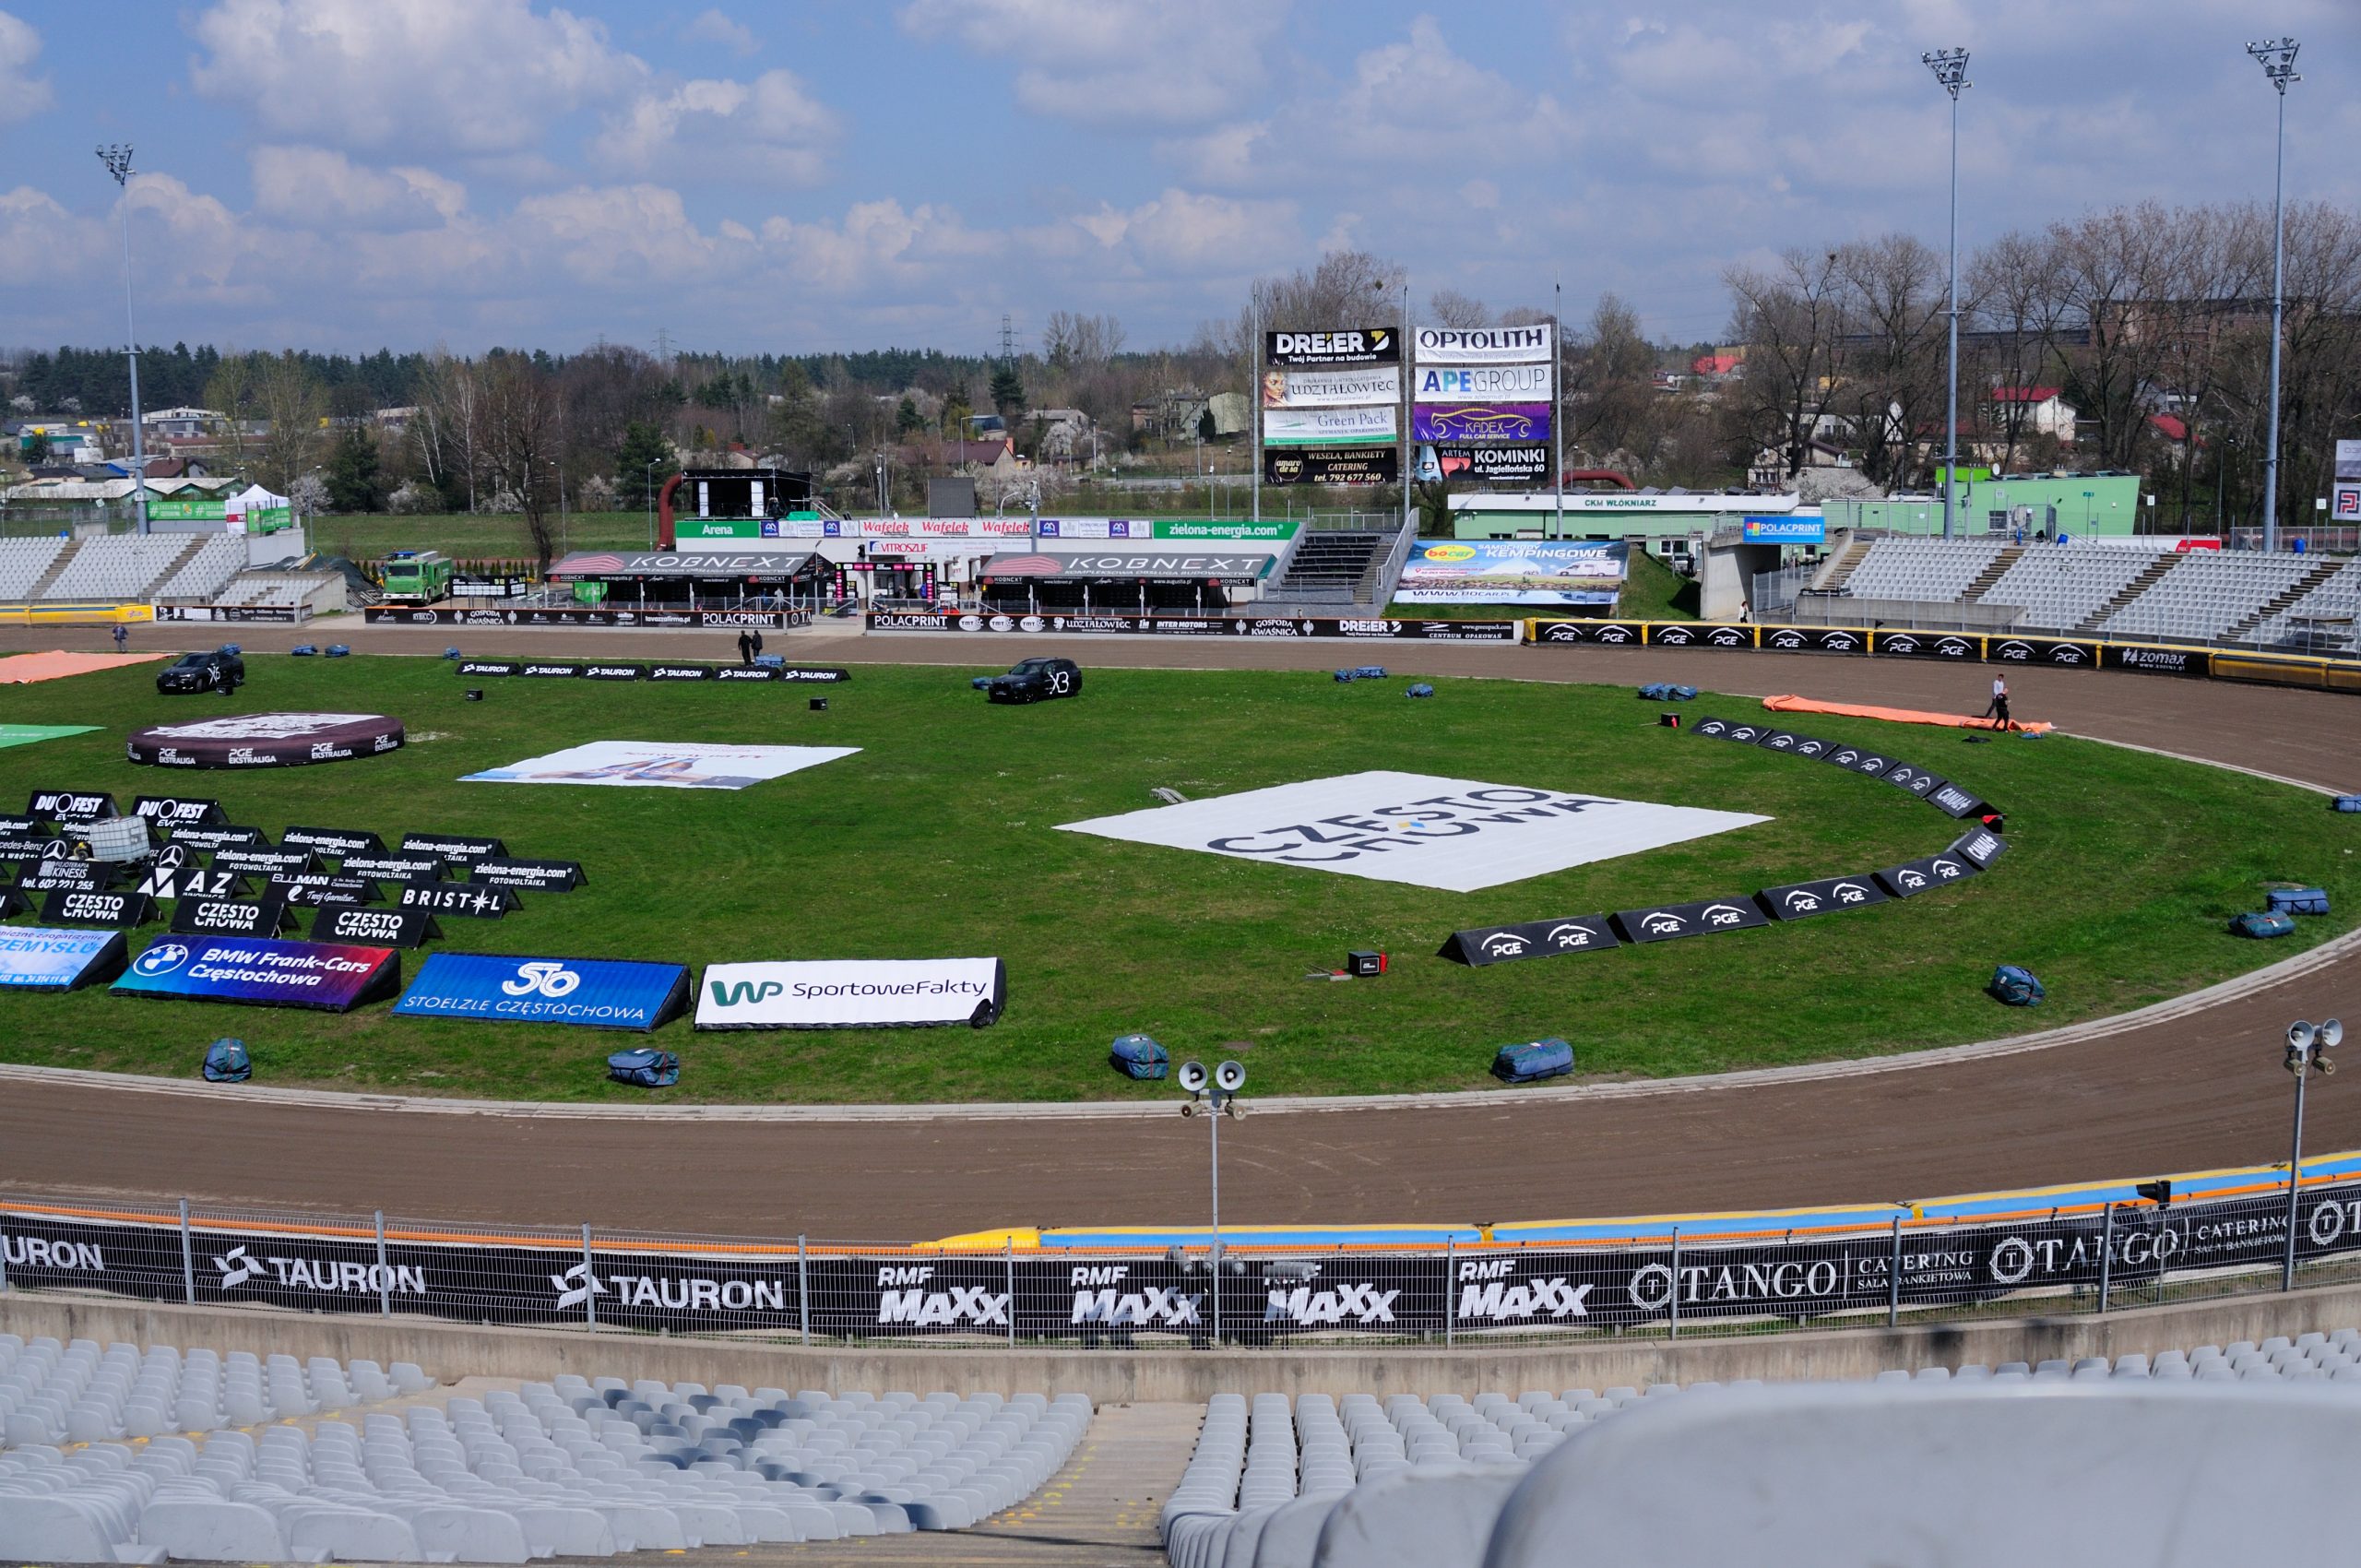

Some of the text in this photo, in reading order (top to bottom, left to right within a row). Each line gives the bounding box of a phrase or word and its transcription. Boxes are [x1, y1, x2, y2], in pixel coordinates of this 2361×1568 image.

[1420, 328, 1542, 349] OPTOLITH
[1347, 353, 1376, 362] budowie
[1318, 411, 1388, 426] Green Pack
[1465, 422, 1504, 434] KADEX
[1345, 450, 1385, 459] BANKIETY
[1475, 449, 1545, 463] KOMINKI
[1535, 464, 1544, 472] 60
[1365, 472, 1382, 481] 560
[1606, 498, 1656, 507] WŁÓKNIARZ
[702, 524, 733, 535] Arena
[863, 522, 909, 533] Wafelek
[922, 522, 968, 535] Wafelek
[982, 522, 1029, 535] Wafelek
[1761, 524, 1822, 532] POLACPRINT
[1486, 550, 1608, 558] KEMPINGOWE
[629, 556, 804, 568] KOBNEXT
[1068, 557, 1262, 570] KOBNEXT
[703, 613, 777, 624] POLACPRINT
[875, 616, 948, 625] POLACPRINT
[1256, 619, 1293, 627] GOSPODA
[1179, 621, 1208, 629] MOTORS
[1252, 627, 1299, 636] KWAŚNICA
[1551, 632, 1574, 641] PGE
[1601, 634, 1625, 643] PGE
[1664, 635, 1687, 644] PGE
[1714, 636, 1738, 646] PGE
[1776, 638, 1799, 647] PGE
[1827, 640, 1851, 649] PGE
[1891, 643, 1913, 653] PGE
[1940, 645, 1964, 656] PGE
[2003, 648, 2027, 659] PGE
[2055, 652, 2079, 663] PGE
[2140, 651, 2187, 665] zomax
[538, 667, 574, 675] TAURON
[599, 668, 635, 676] TAURON
[732, 671, 769, 679] TAURON
[800, 671, 836, 680] TAURON
[159, 748, 177, 756] PGE
[229, 748, 253, 756] PGE
[312, 742, 334, 753] PGE
[312, 749, 352, 758] EKSTRALIGA
[159, 756, 196, 765] EKSTRALIGA
[229, 755, 277, 764] EKSTRALIGA
[53, 868, 89, 878] KINESIS
[475, 863, 566, 878] zielona-energia.com
[1940, 866, 1961, 879] PGE
[272, 873, 329, 885] ELLMAN
[490, 877, 546, 886] FOTOWOLTAIKA
[1905, 876, 1926, 889] PGE
[77, 881, 94, 891] 255
[1841, 890, 1865, 904] PGE
[1794, 898, 1817, 911] PGE
[1712, 911, 1739, 925] PGE
[1652, 920, 1680, 934] PGE
[1559, 932, 1588, 947] PGE
[1492, 941, 1522, 956] PGE
[201, 948, 372, 973] BMW Frank-Cars
[188, 963, 323, 987] Częstochowa
[710, 980, 783, 1007] WP
[792, 980, 987, 1000] SportoweFakty
[405, 996, 644, 1020] STOELZLE CZĘSTOCHOWA
[2036, 1229, 2178, 1273] TANGO
[267, 1256, 426, 1295] TAURON
[878, 1265, 935, 1287] RMF
[1071, 1265, 1129, 1287] RMF
[1459, 1260, 1516, 1282] RMF
[1680, 1260, 1836, 1301] TANGO
[1857, 1278, 1889, 1289] SALA
[611, 1276, 784, 1310] TAURON
